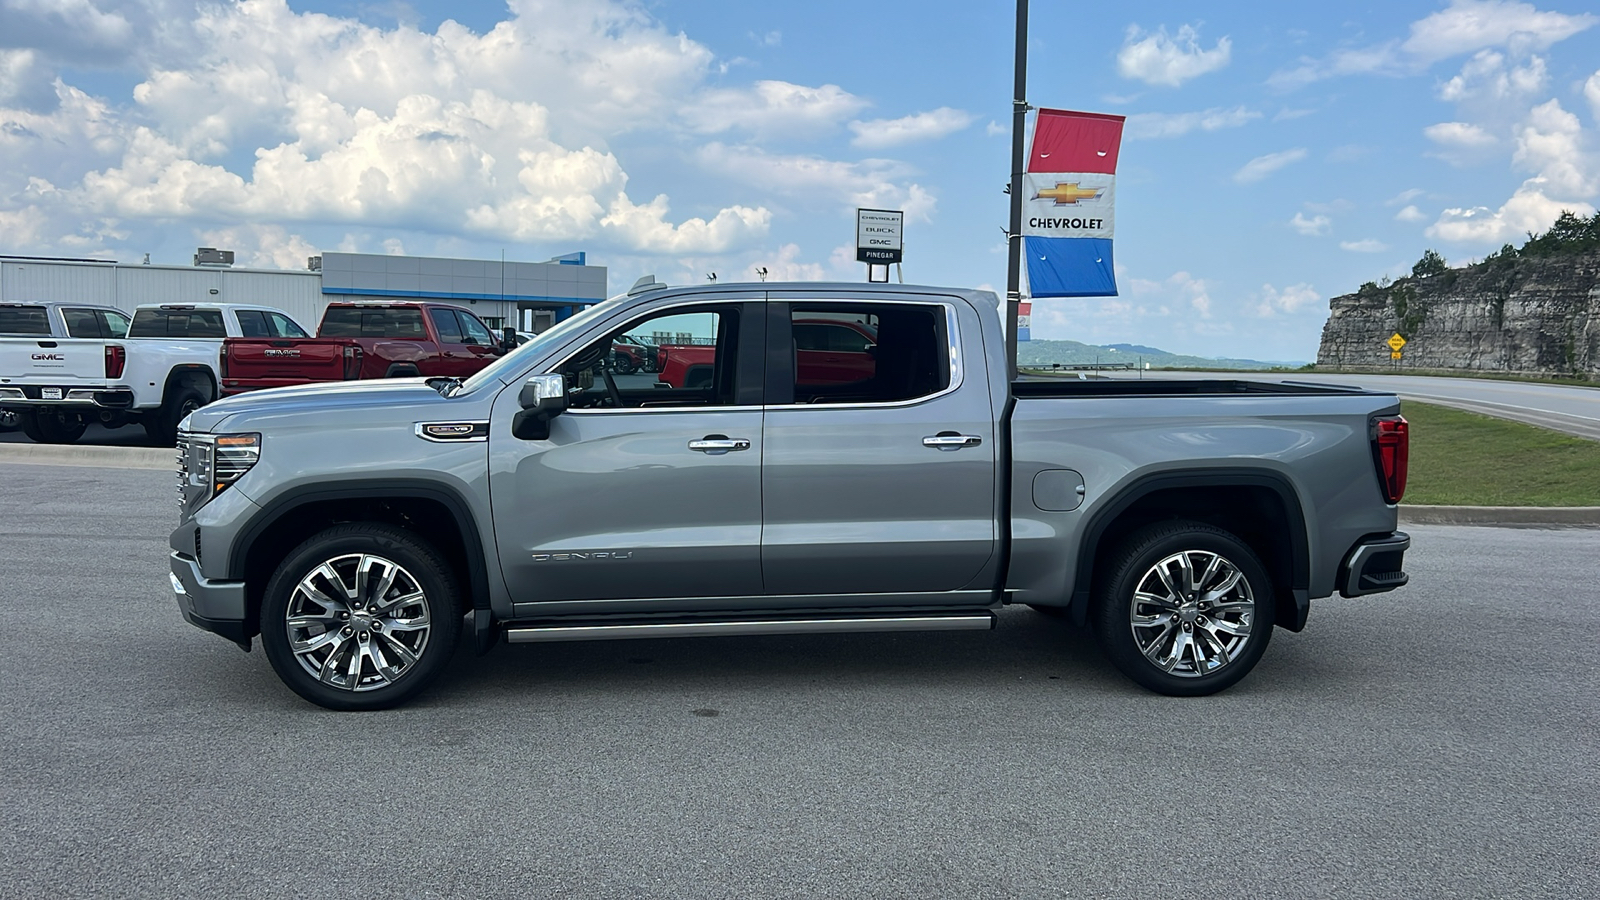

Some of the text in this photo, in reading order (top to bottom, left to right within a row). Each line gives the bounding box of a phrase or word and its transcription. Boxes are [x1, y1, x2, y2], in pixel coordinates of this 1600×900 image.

[1029, 217, 1103, 230] CHEVROLET
[866, 251, 894, 259] PINEGAR
[31, 353, 64, 361] GMC
[264, 349, 300, 358] GMC
[532, 551, 633, 562] DENALI
